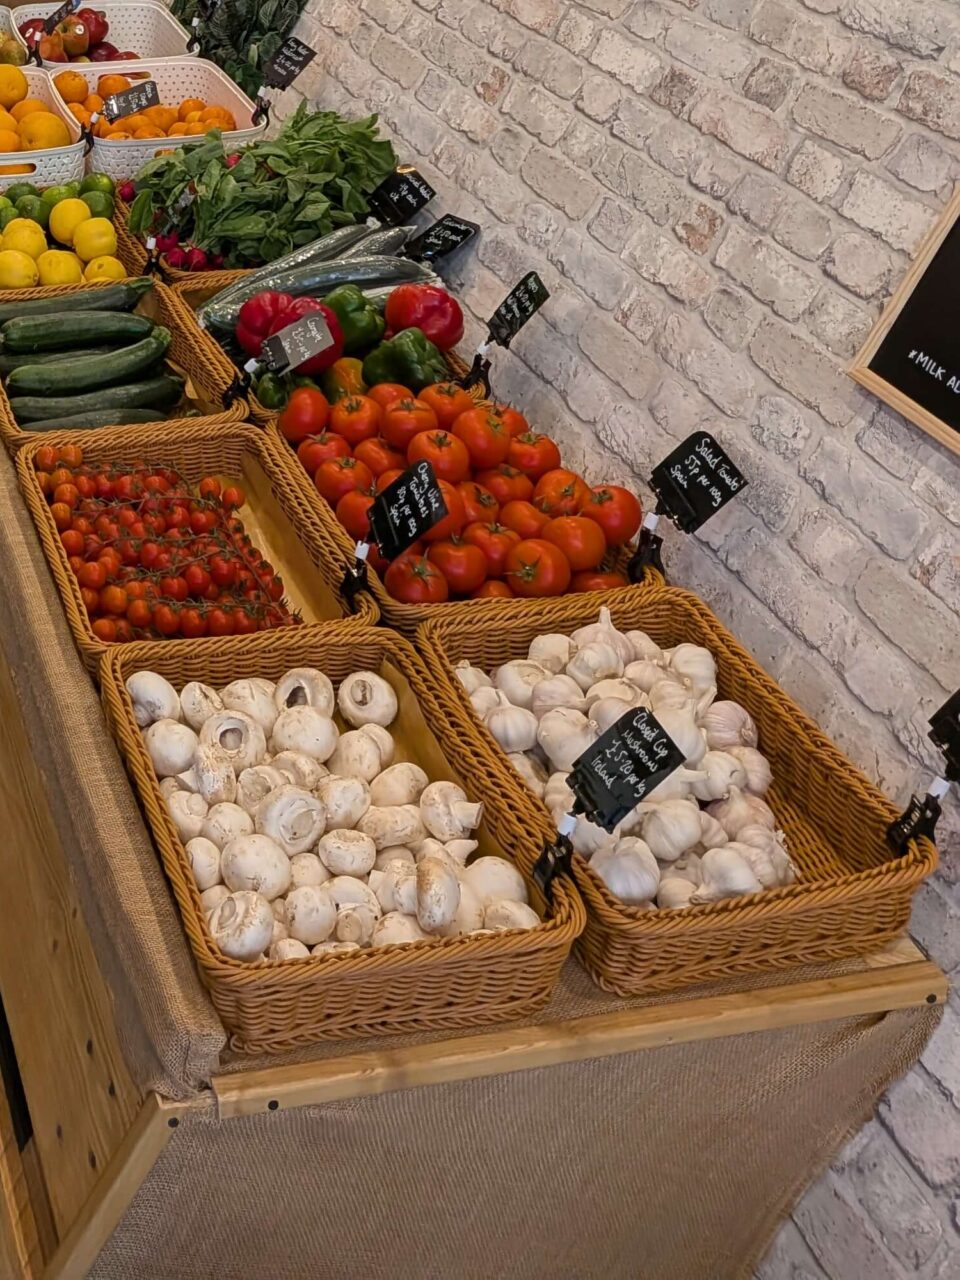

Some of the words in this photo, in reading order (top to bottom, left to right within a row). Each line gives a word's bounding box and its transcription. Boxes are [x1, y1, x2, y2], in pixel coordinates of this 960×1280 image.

[406, 194, 417, 208] each
[671, 464, 688, 488] Spain
[685, 455, 701, 476] 55p
[696, 475, 710, 486] per
[709, 486, 722, 507] 100g
[696, 438, 722, 470] Salad
[717, 464, 740, 490] Tomato
[410, 476, 429, 518] Tomatoes
[418, 462, 429, 494] Cherry
[428, 488, 440, 511] Vine
[390, 504, 400, 526] Spain
[400, 504, 412, 516] per
[408, 517, 417, 538] 100g
[622, 729, 658, 772] Mushrooms
[632, 712, 659, 742] Closed
[654, 738, 668, 760] Cup
[591, 754, 617, 790] Ireland
[623, 773, 640, 784] per
[634, 779, 646, 798] kg
